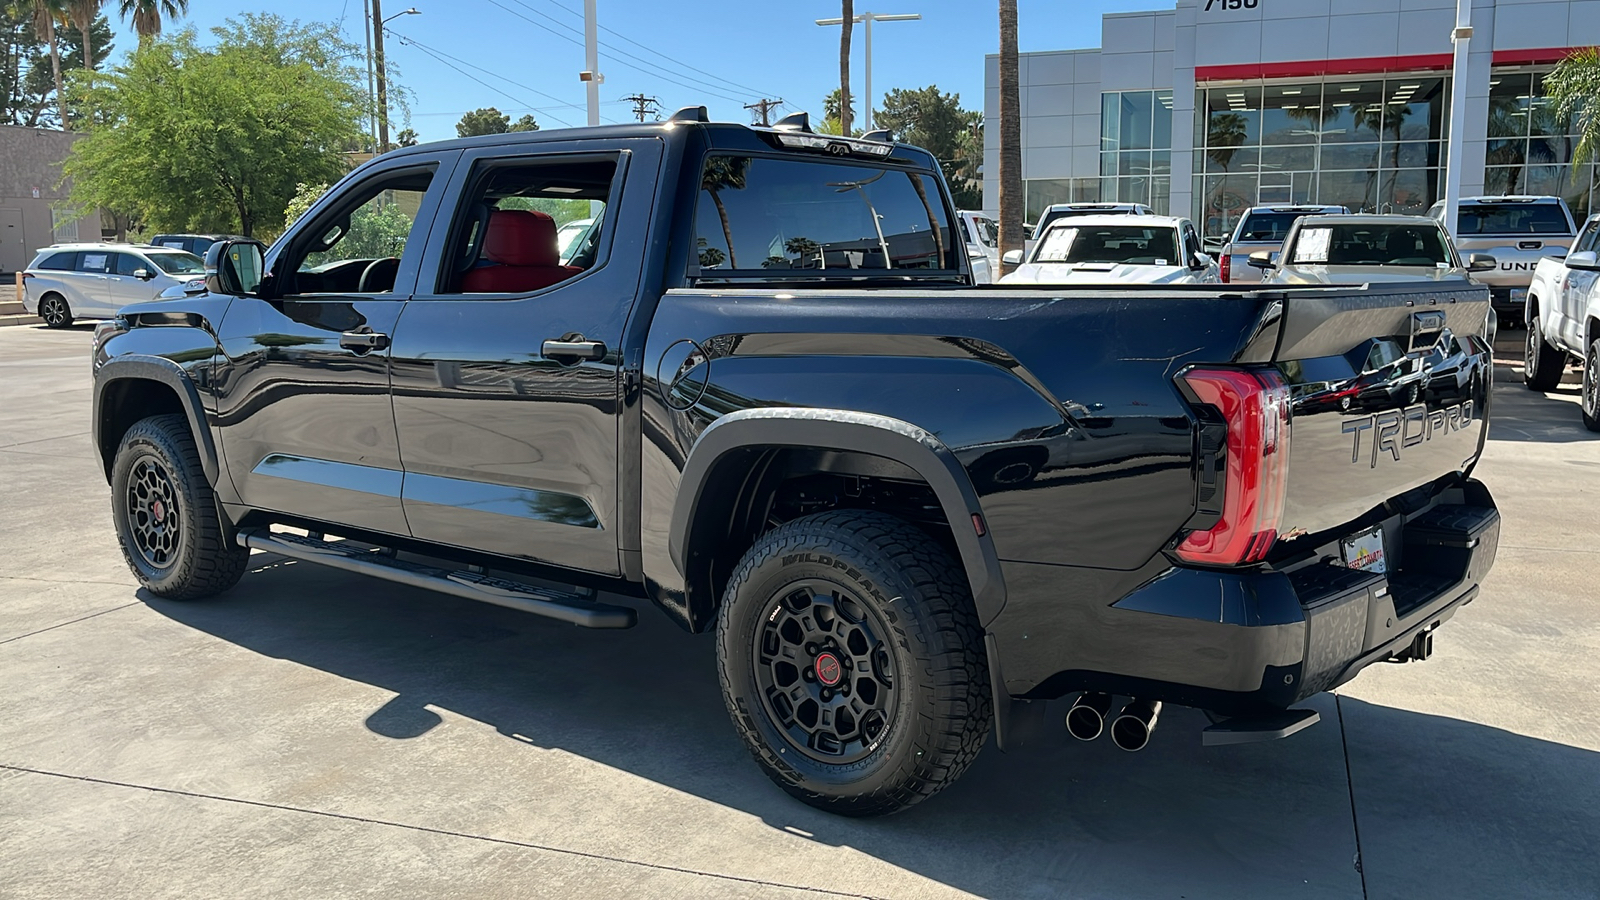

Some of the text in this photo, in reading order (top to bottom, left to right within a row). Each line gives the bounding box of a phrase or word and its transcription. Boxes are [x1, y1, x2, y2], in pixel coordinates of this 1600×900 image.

[1341, 399, 1474, 469] TRD PRO
[781, 552, 887, 605] WILDPEAK
